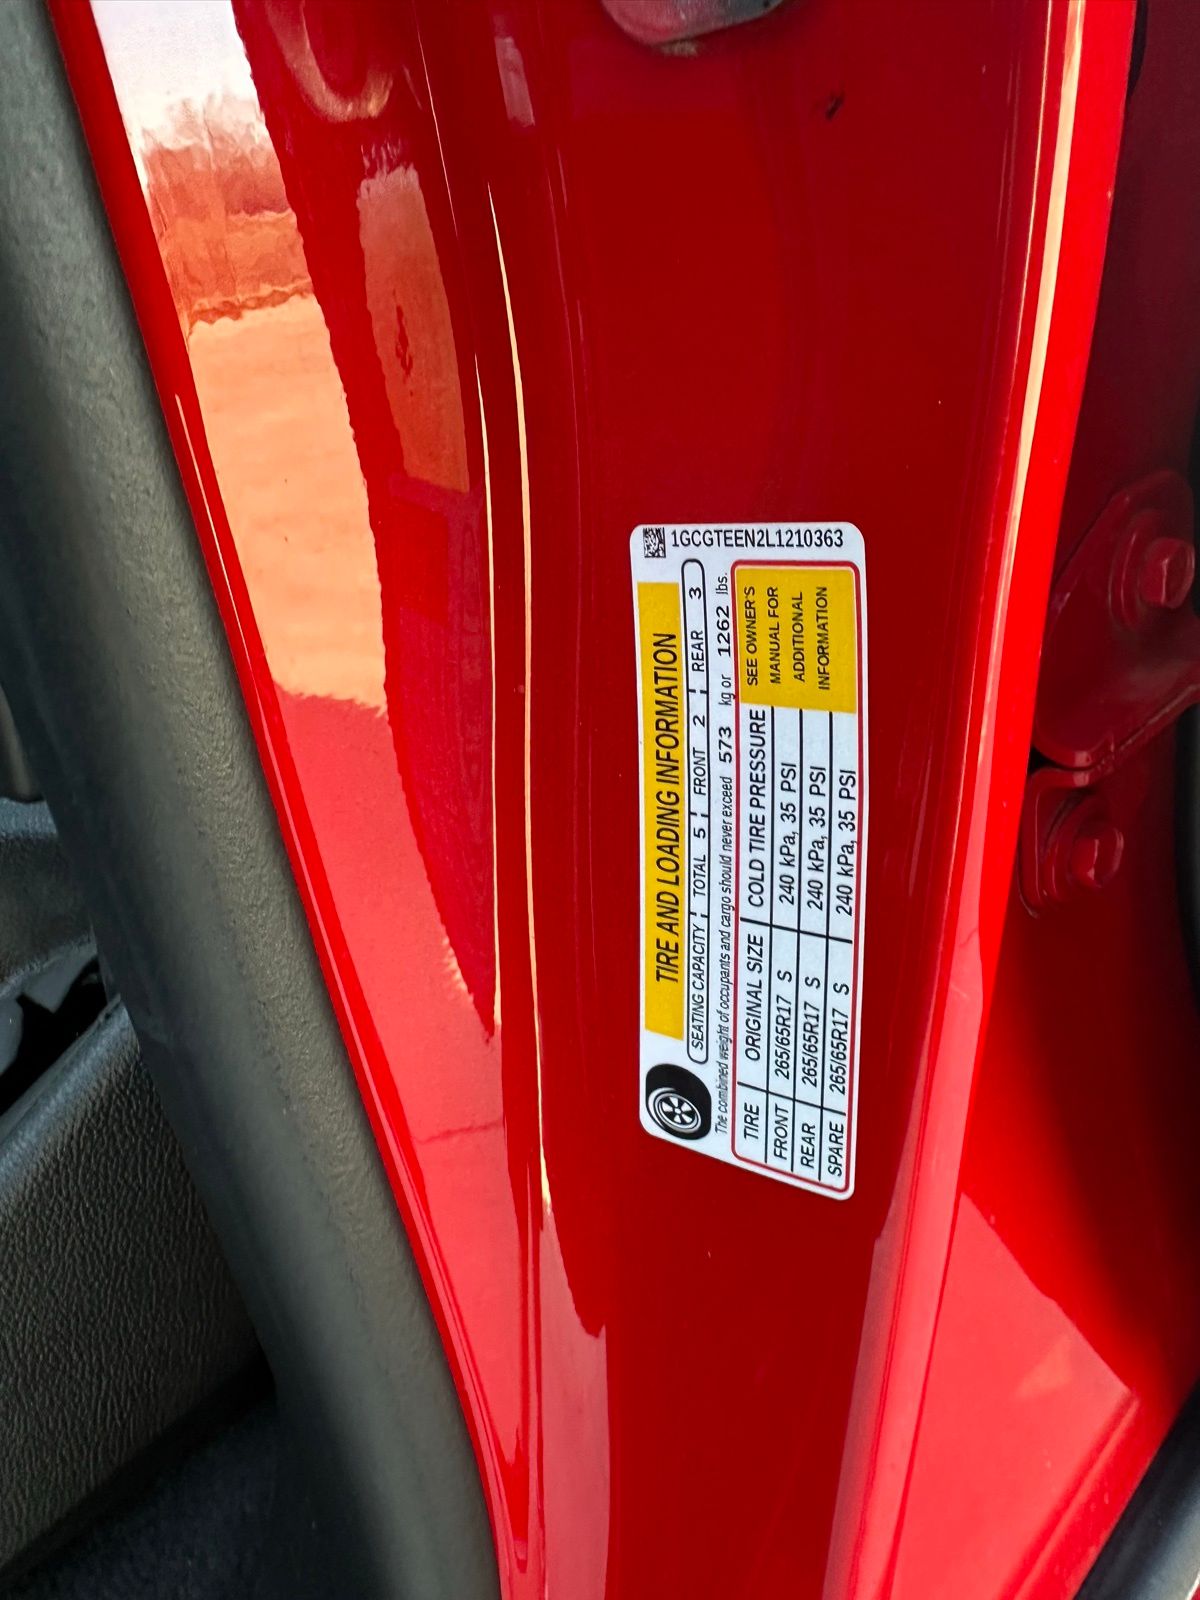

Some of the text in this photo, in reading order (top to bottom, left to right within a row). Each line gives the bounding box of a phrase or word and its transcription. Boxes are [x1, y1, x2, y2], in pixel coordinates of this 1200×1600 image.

[671, 529, 844, 548] 1GCGTEEN2L1210363
[744, 586, 758, 686] SEE OWNER'S
[767, 586, 781, 684] MANUAL FOR
[792, 592, 805, 682] ADDITIONAL
[816, 586, 830, 690] INFORMATION
[653, 632, 680, 983] TIRE AND LOADING INFORMATION
[689, 587, 707, 1050] SEATING CAPACITY TOTAL 5 FRONT 2 REAR 3
[715, 573, 736, 1135] The combined weight of occupants and cargo should never exceed 573 kg or 1262 lbs.
[748, 709, 766, 907] COLD TIRE PRESSURE
[746, 934, 763, 1061] ORIGINAL SIZE
[774, 763, 799, 1161] FRONT 265/65R17 S 240 kPa, 35 PSI
[800, 766, 827, 1169] REAR 265/65R17 S 240 kPa, 35 PSI
[828, 769, 857, 1177] SPARE 265/65R17 S 240 kPa, 35 PSI
[744, 1102, 760, 1140] TIRE
